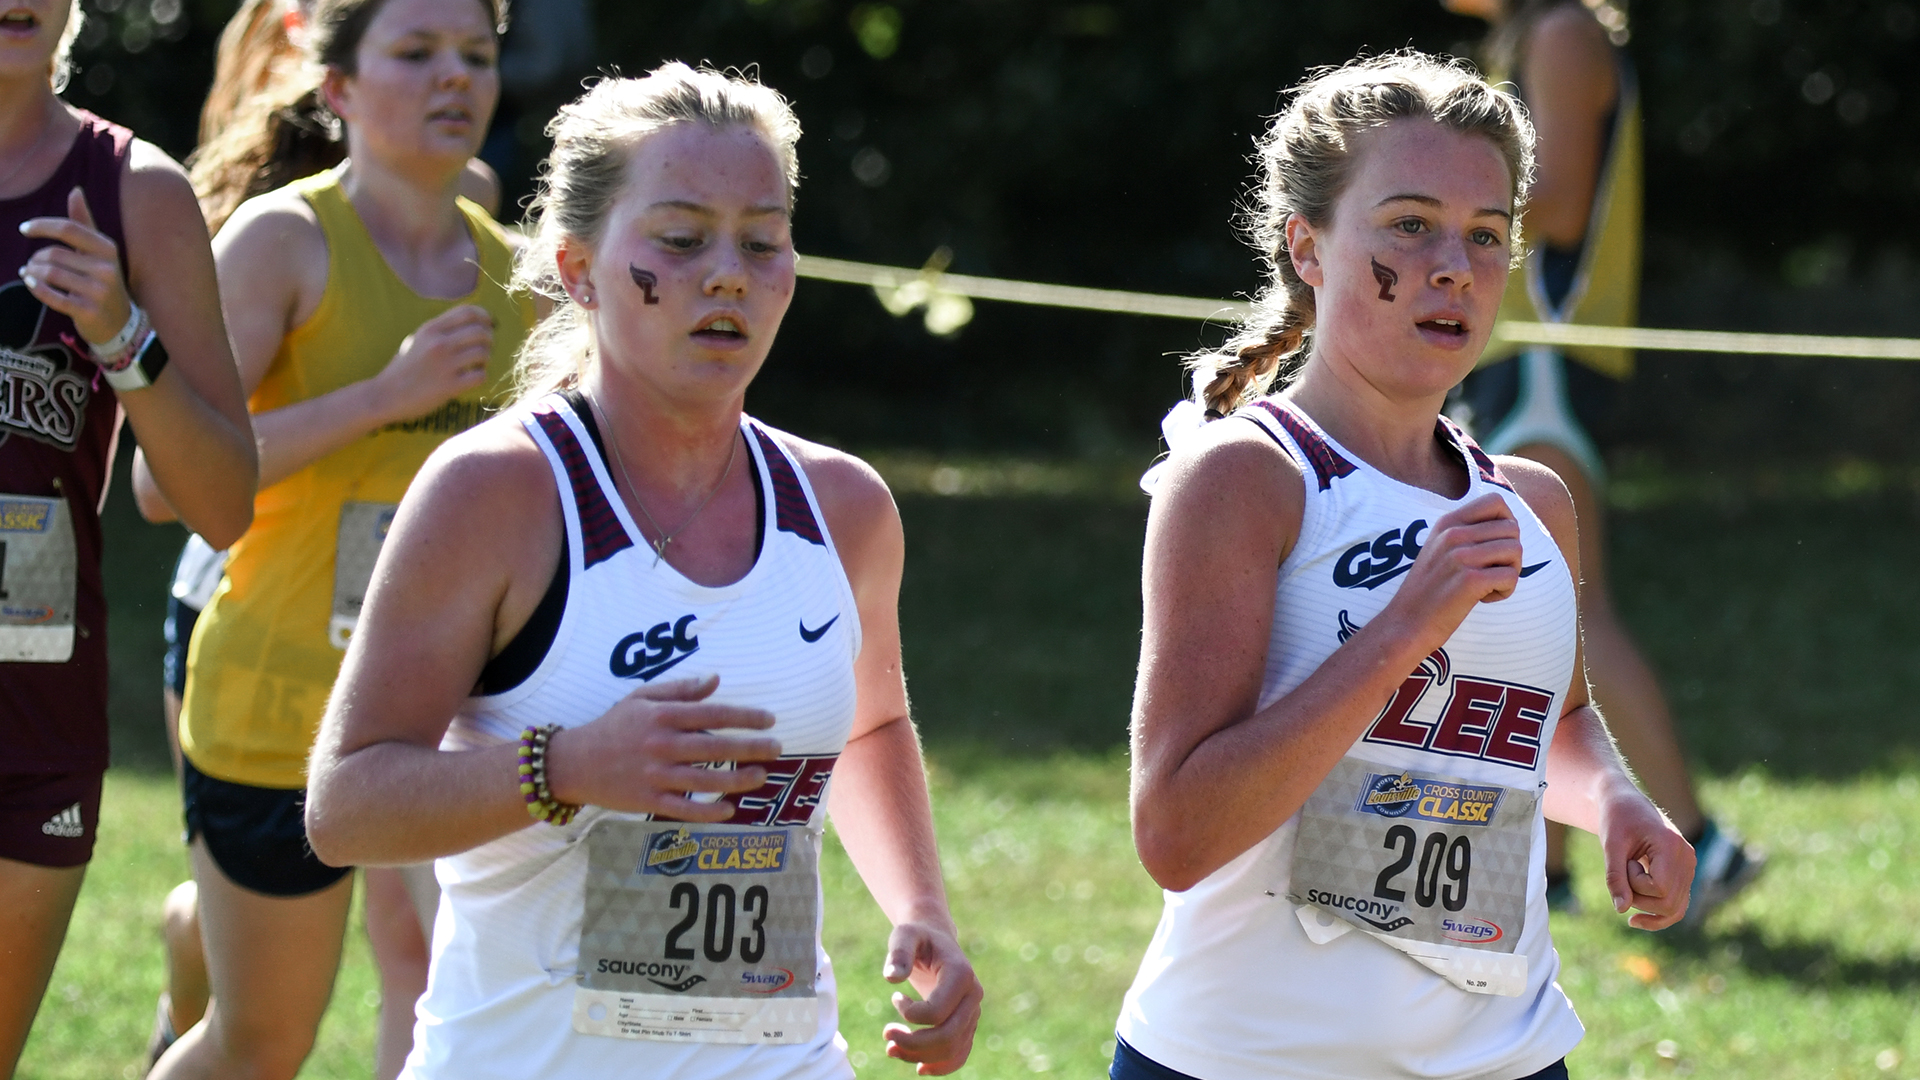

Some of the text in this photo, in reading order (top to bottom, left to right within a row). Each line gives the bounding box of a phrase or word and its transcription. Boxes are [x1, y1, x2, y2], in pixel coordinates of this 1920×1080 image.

[0, 371, 86, 443] RS
[1333, 519, 1428, 588] GSC
[609, 614, 699, 678] GSC
[1362, 674, 1555, 771] LEE
[1367, 786, 1420, 804] Louisville
[1423, 784, 1500, 802] CROSS COUNTRY
[1417, 796, 1493, 822] CLASSIC
[701, 835, 786, 848] CROSS COUNTRY
[698, 847, 782, 870] CLASSIC
[1374, 824, 1471, 912] 209
[1307, 888, 1394, 920] saucony
[664, 882, 769, 964] 203
[1441, 919, 1494, 937] Swags
[597, 958, 685, 981] saucony
[1466, 978, 1487, 988] No. 209
